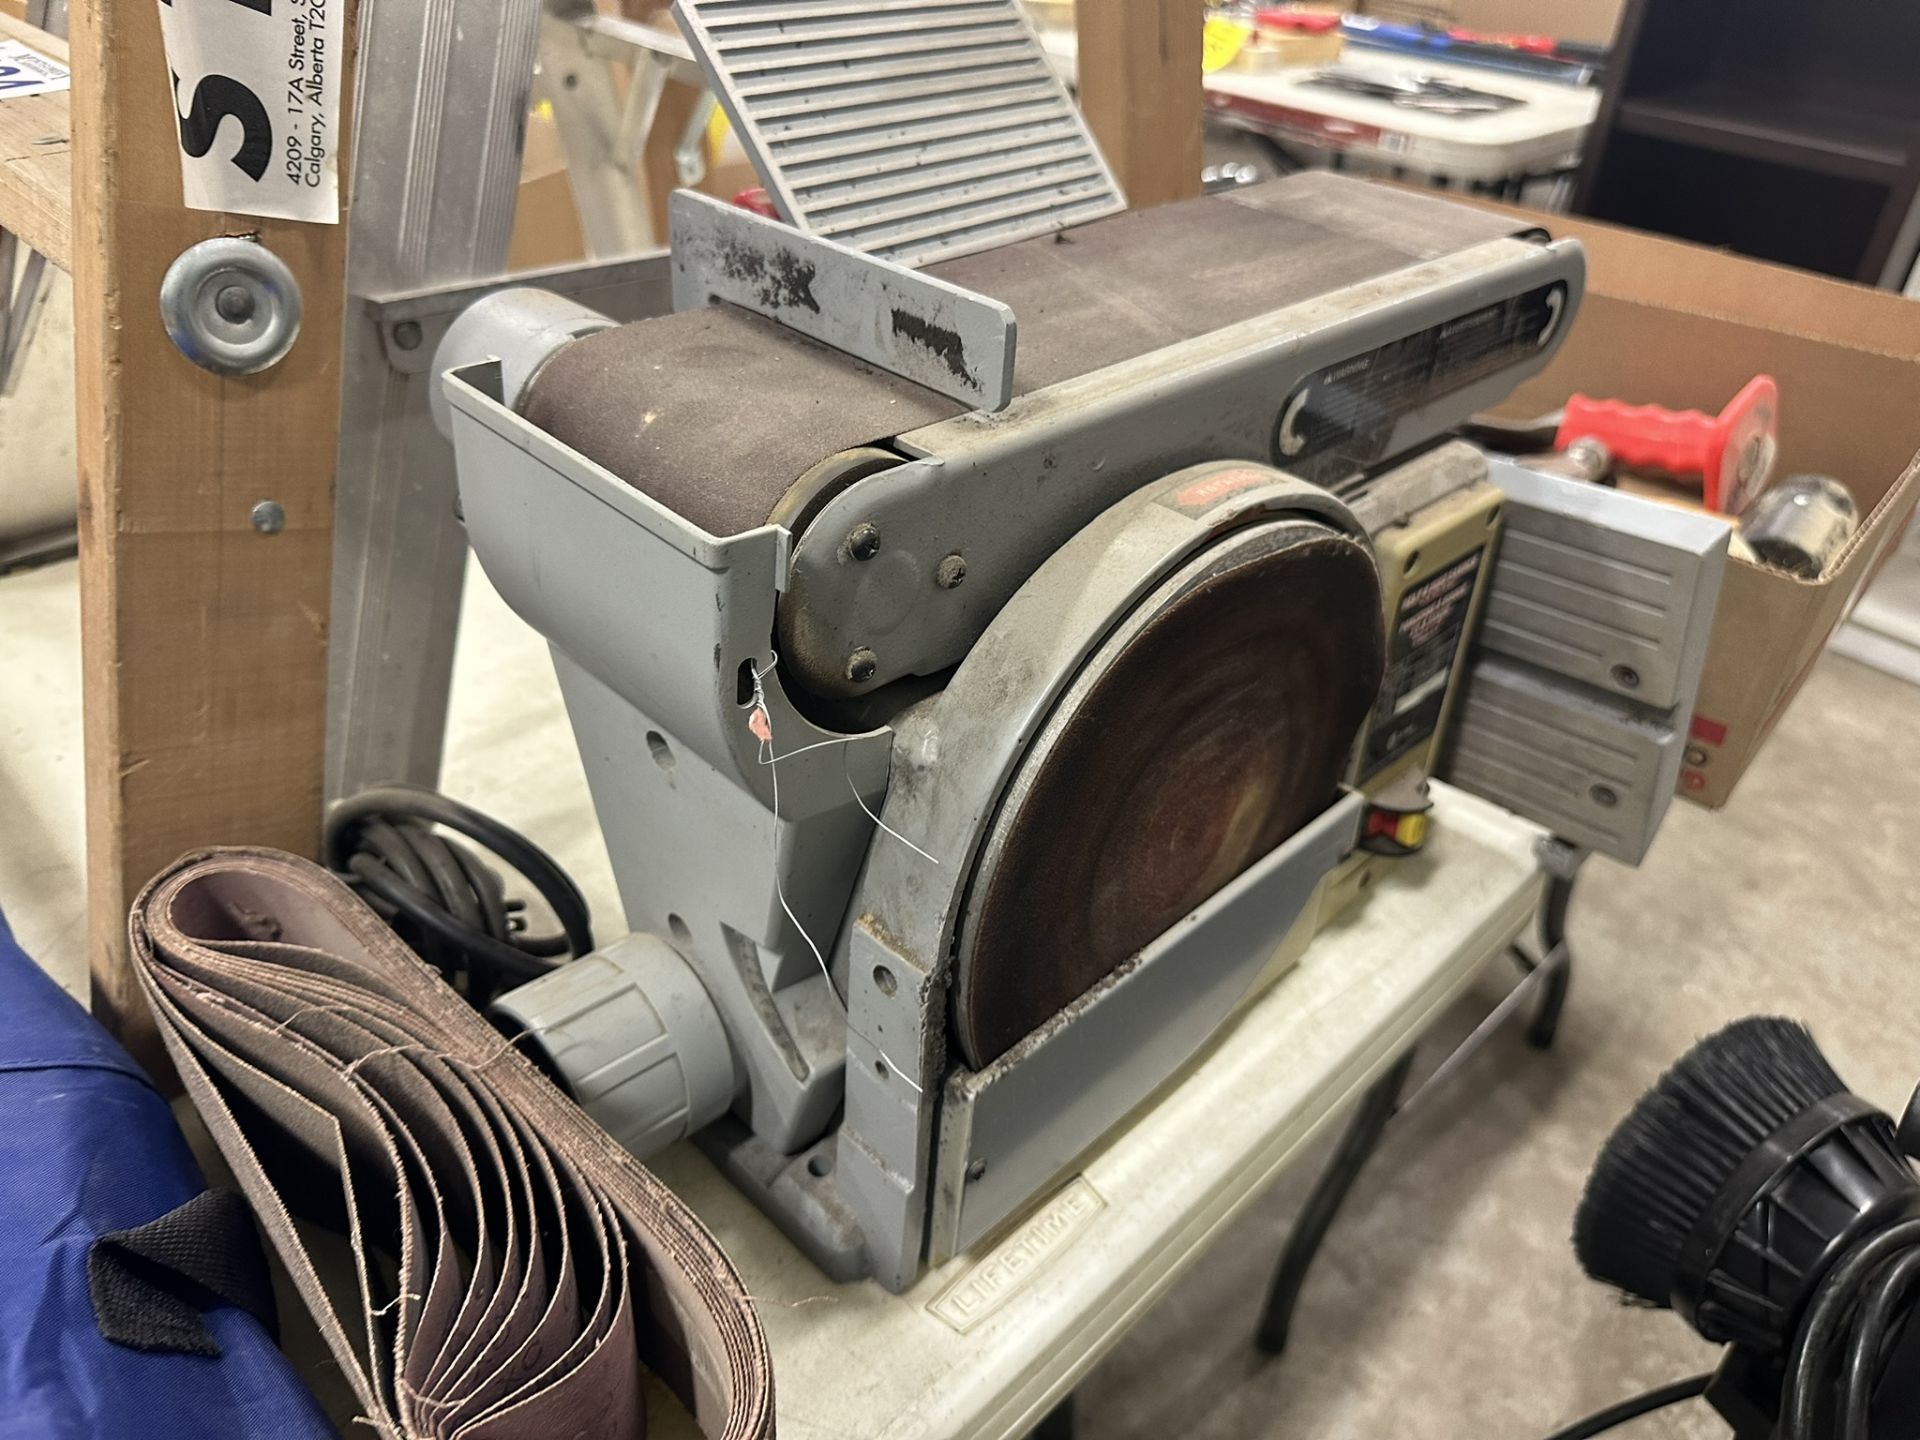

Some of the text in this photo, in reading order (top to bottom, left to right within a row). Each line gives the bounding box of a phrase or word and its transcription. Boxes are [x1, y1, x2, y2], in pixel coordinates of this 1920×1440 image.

[288, 14, 308, 71] Street,
[305, 37, 325, 107] Alberta
[287, 77, 303, 114] 17A
[286, 135, 302, 186] 4209
[304, 113, 326, 188] Calgary,
[950, 1193, 1086, 1316] LIFETIME
